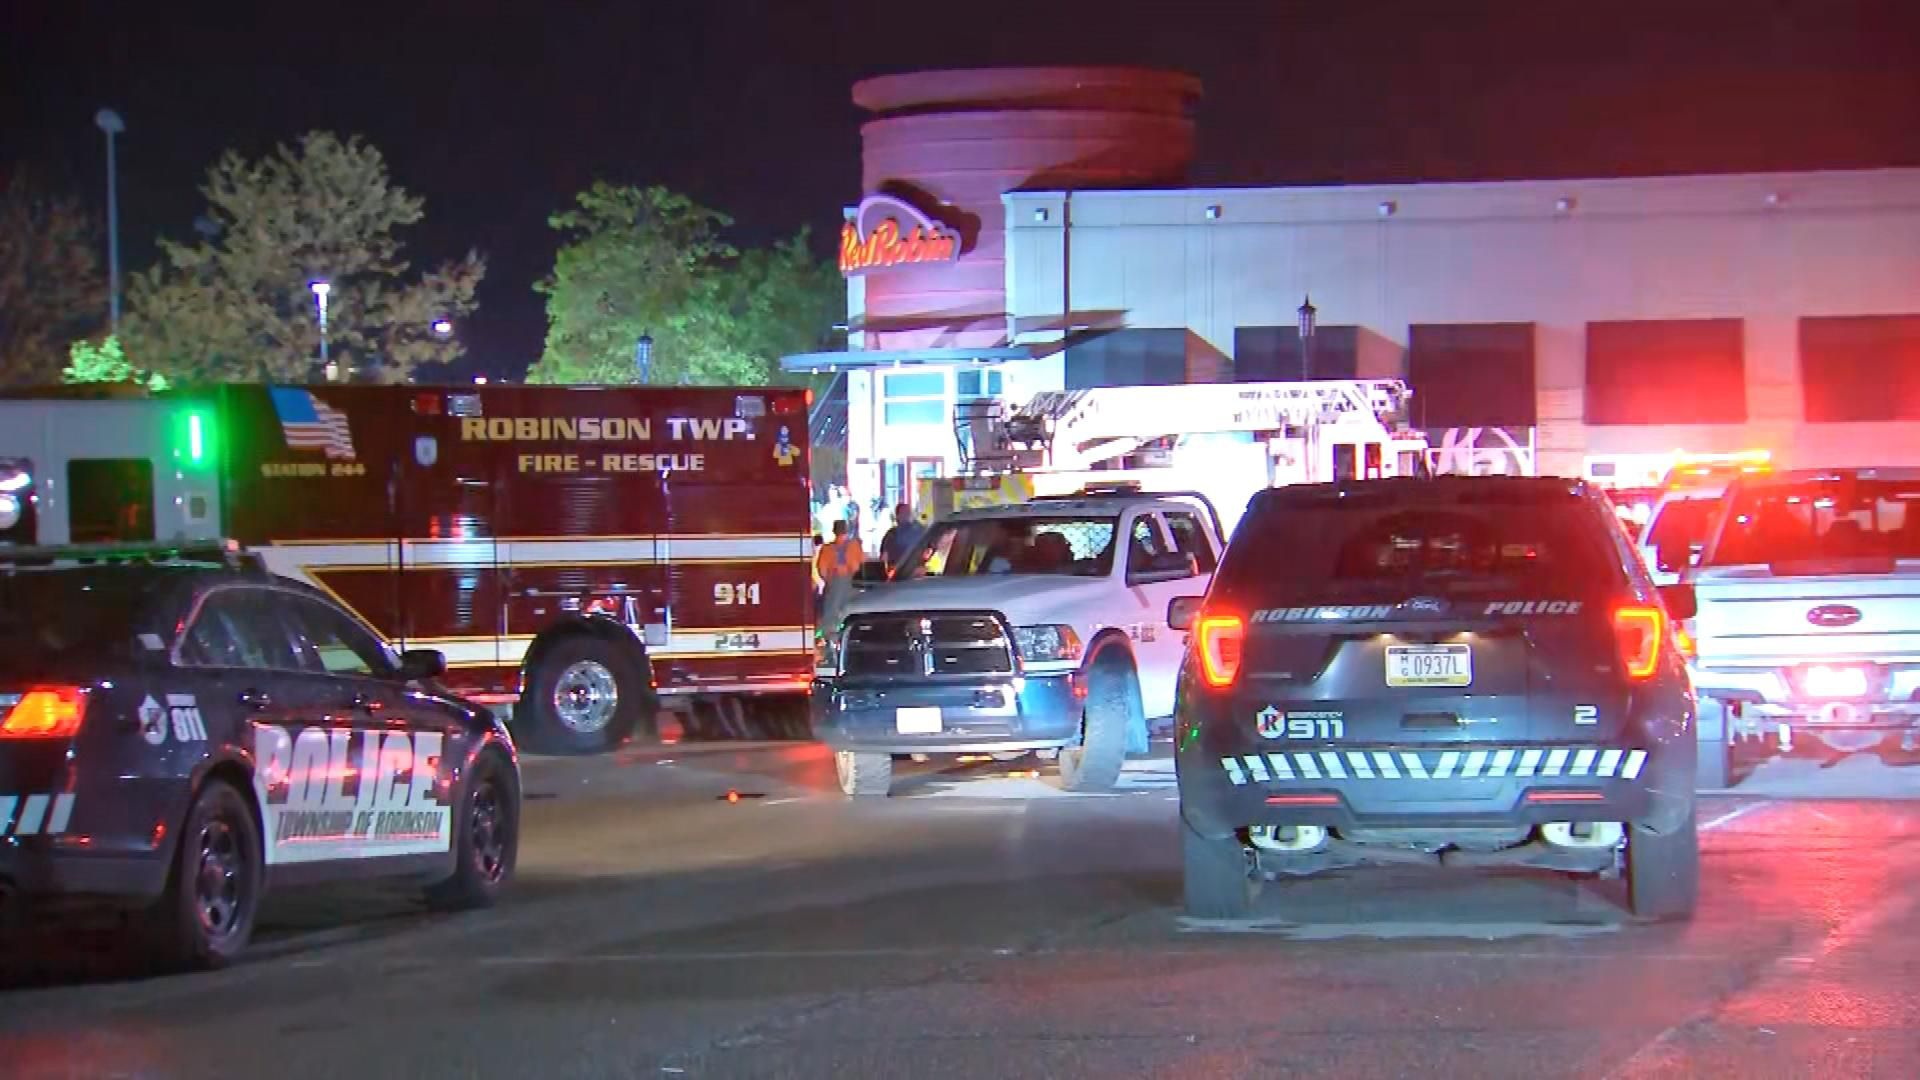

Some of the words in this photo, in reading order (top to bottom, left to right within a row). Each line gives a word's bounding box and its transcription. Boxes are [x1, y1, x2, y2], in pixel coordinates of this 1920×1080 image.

[838, 221, 877, 271] Red
[873, 216, 955, 267] Robin
[460, 416, 651, 441] ROBINSON
[666, 416, 756, 441] TWP.
[517, 454, 580, 473] FIRE
[602, 453, 704, 473] RESCUE
[713, 582, 761, 605] 911
[1251, 605, 1393, 624] ROBINSON
[1484, 601, 1583, 616] POLICE
[714, 633, 761, 649] 244
[1414, 655, 1463, 676] 0937L
[1575, 705, 1597, 725] 2
[1287, 719, 1344, 739] 911
[254, 724, 444, 806] POLICE
[353, 811, 374, 836] OF
[374, 811, 444, 840] ROBINSON
